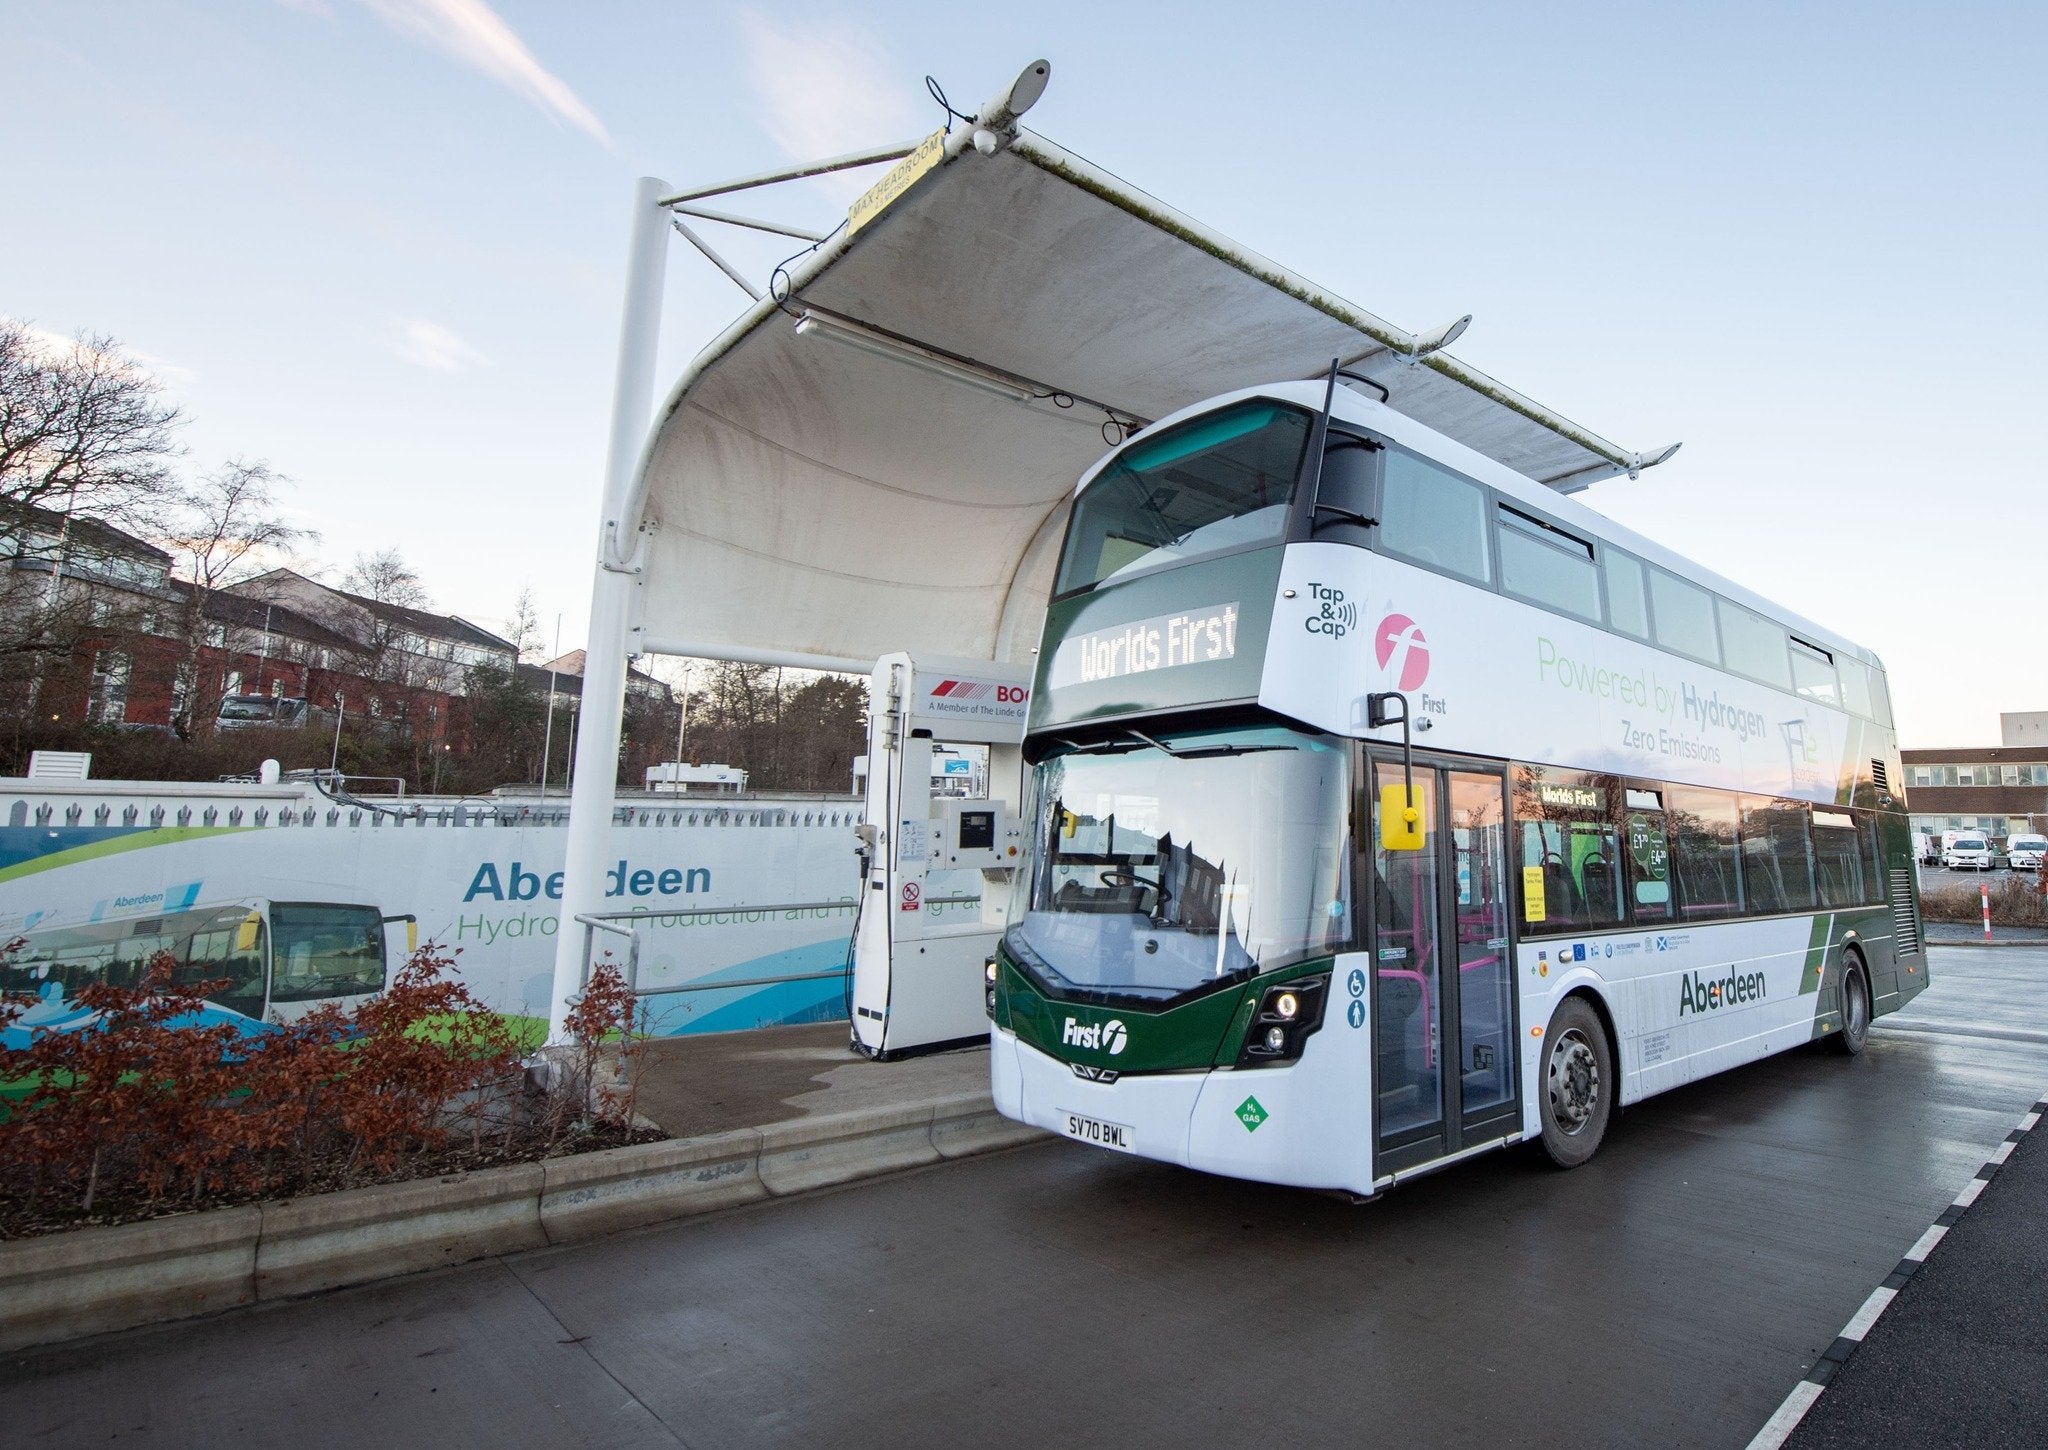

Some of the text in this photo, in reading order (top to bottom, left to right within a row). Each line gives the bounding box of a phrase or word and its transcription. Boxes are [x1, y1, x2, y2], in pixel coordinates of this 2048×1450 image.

[1308, 583, 1344, 605] Tap
[1321, 602, 1335, 620] &
[1305, 616, 1346, 640] Cap
[1081, 606, 1237, 682] Worlds First
[1537, 636, 1766, 743] Powered by Hydrogen
[929, 702, 935, 710] A
[937, 703, 969, 713] Member
[971, 705, 979, 714] of
[981, 706, 994, 715] The
[1017, 709, 1026, 718] Gr
[1422, 693, 1447, 715] First
[1621, 719, 1721, 764] Zero Emissions
[1542, 786, 1597, 807] Worlds First
[463, 860, 712, 903] Abedeen
[113, 892, 164, 908] Aberdeen
[1679, 965, 1767, 1017] Aberdeen
[1062, 1017, 1101, 1050] First
[1242, 1113, 1260, 1124] GAS
[1069, 1115, 1127, 1148] SV70 BWL
